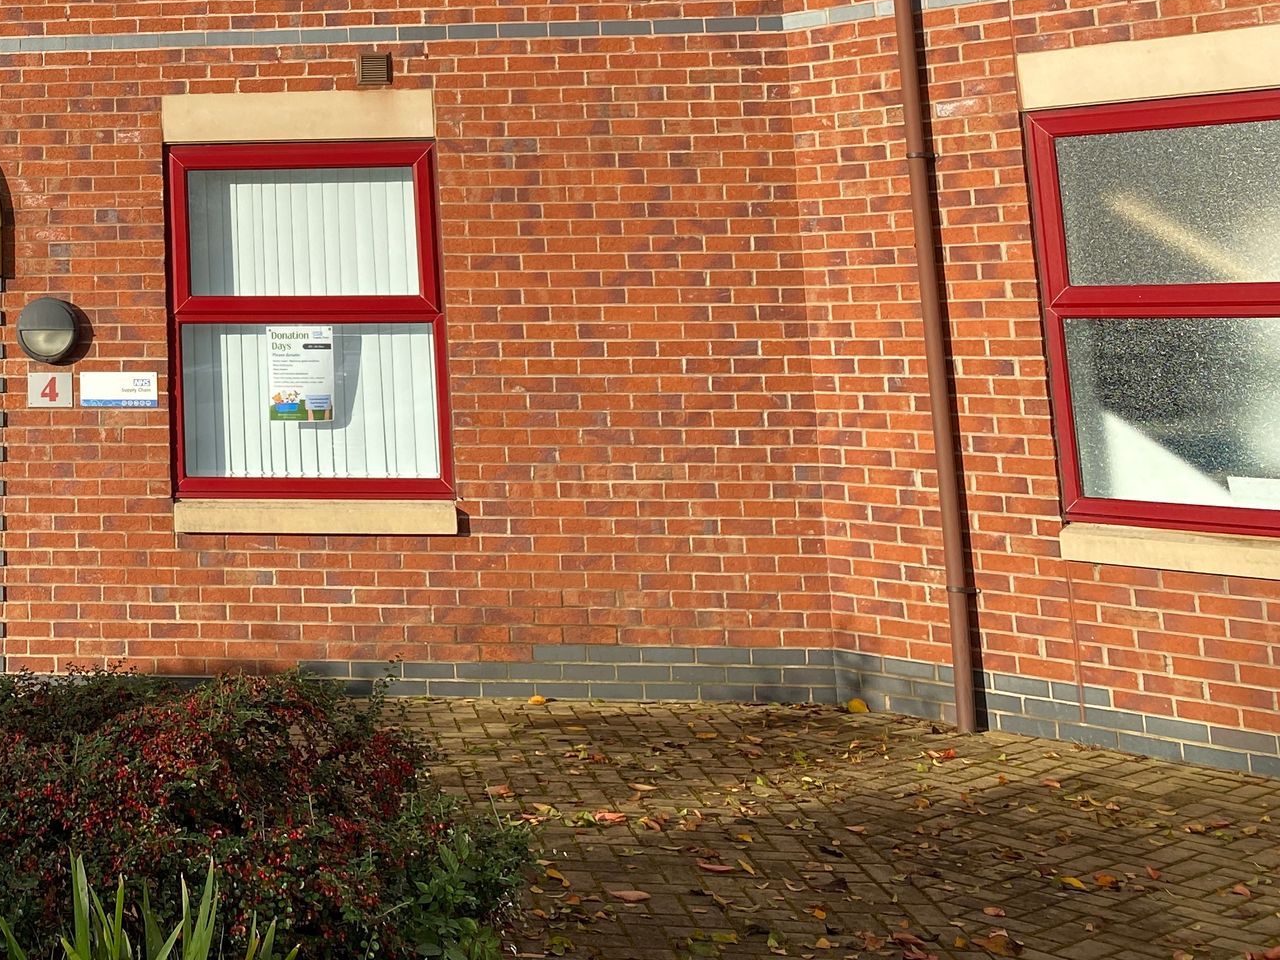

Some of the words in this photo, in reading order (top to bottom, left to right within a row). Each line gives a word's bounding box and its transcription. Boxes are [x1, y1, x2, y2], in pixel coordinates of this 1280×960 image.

[271, 331, 309, 340] Donation
[271, 342, 292, 351] Days
[40, 376, 59, 402] 4
